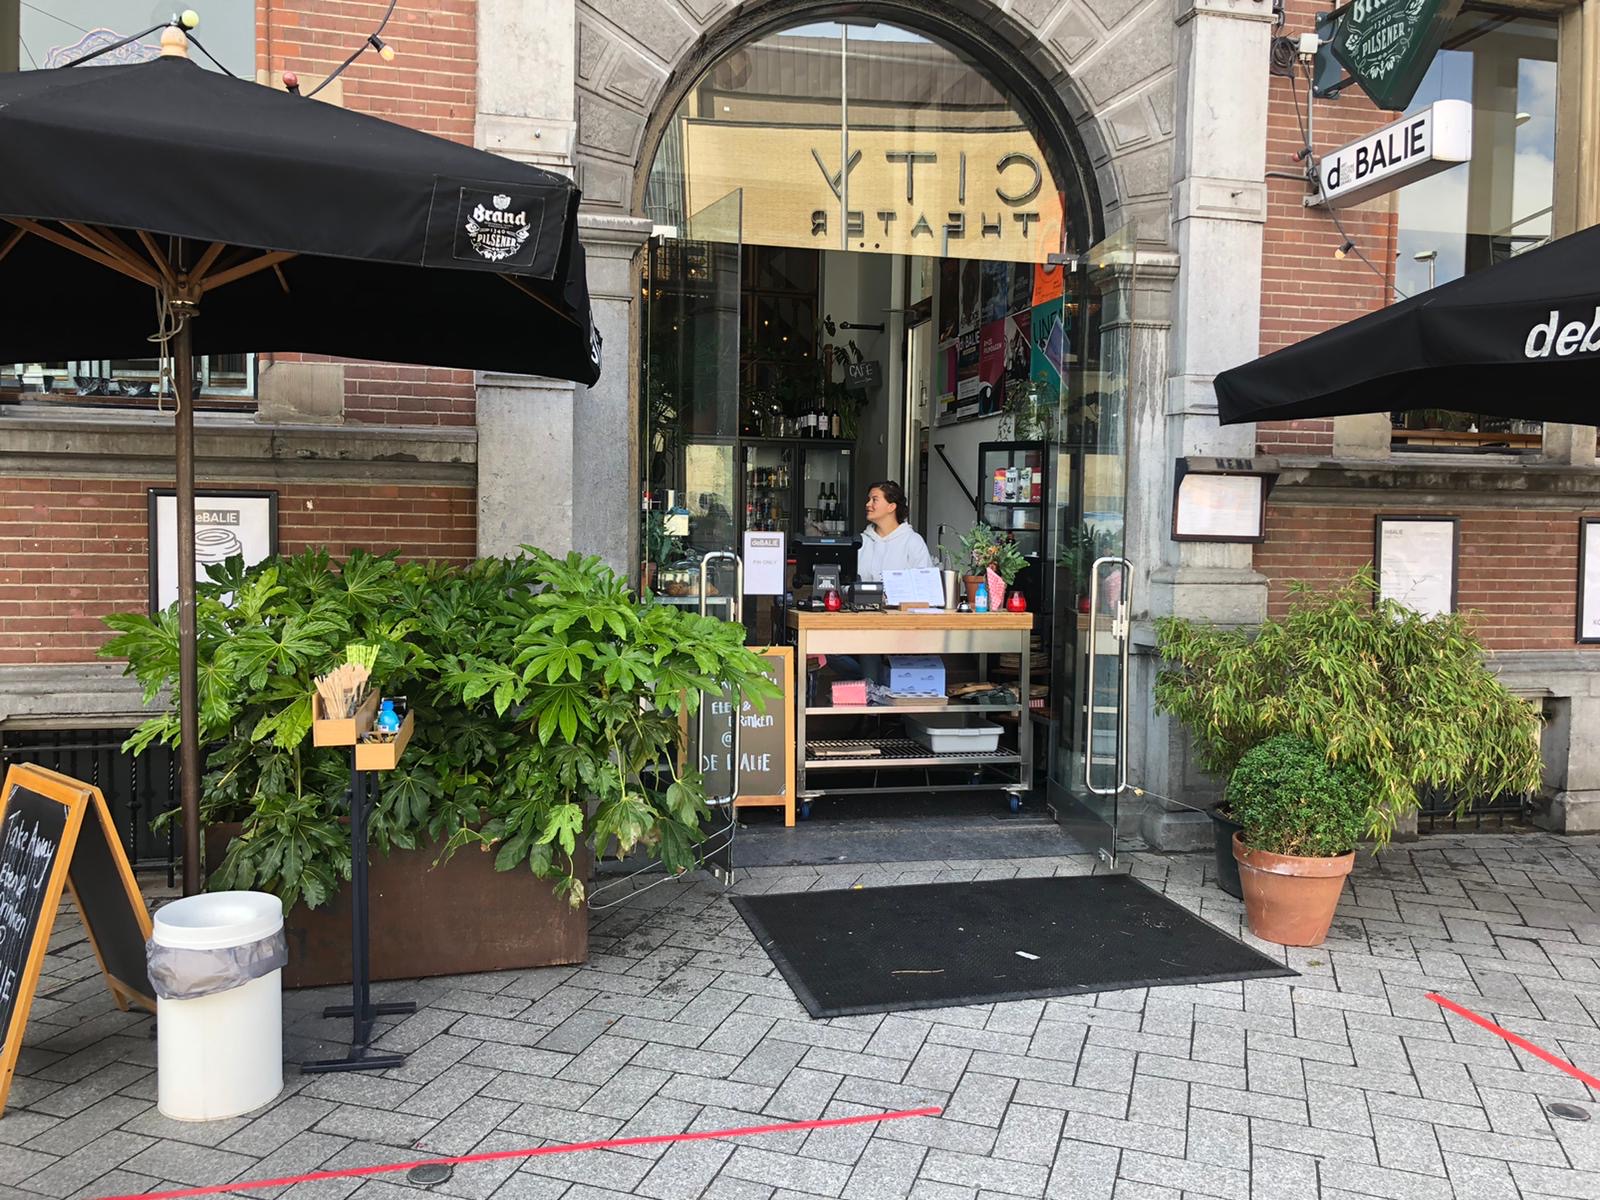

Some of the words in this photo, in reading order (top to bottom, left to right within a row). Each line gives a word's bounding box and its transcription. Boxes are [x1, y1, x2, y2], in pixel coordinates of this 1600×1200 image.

[1362, 22, 1405, 57] PILSENER
[1355, 119, 1425, 180] BALIE
[473, 203, 526, 226] Brand
[477, 233, 517, 248] PILSENER
[195, 511, 239, 523] eBALIE
